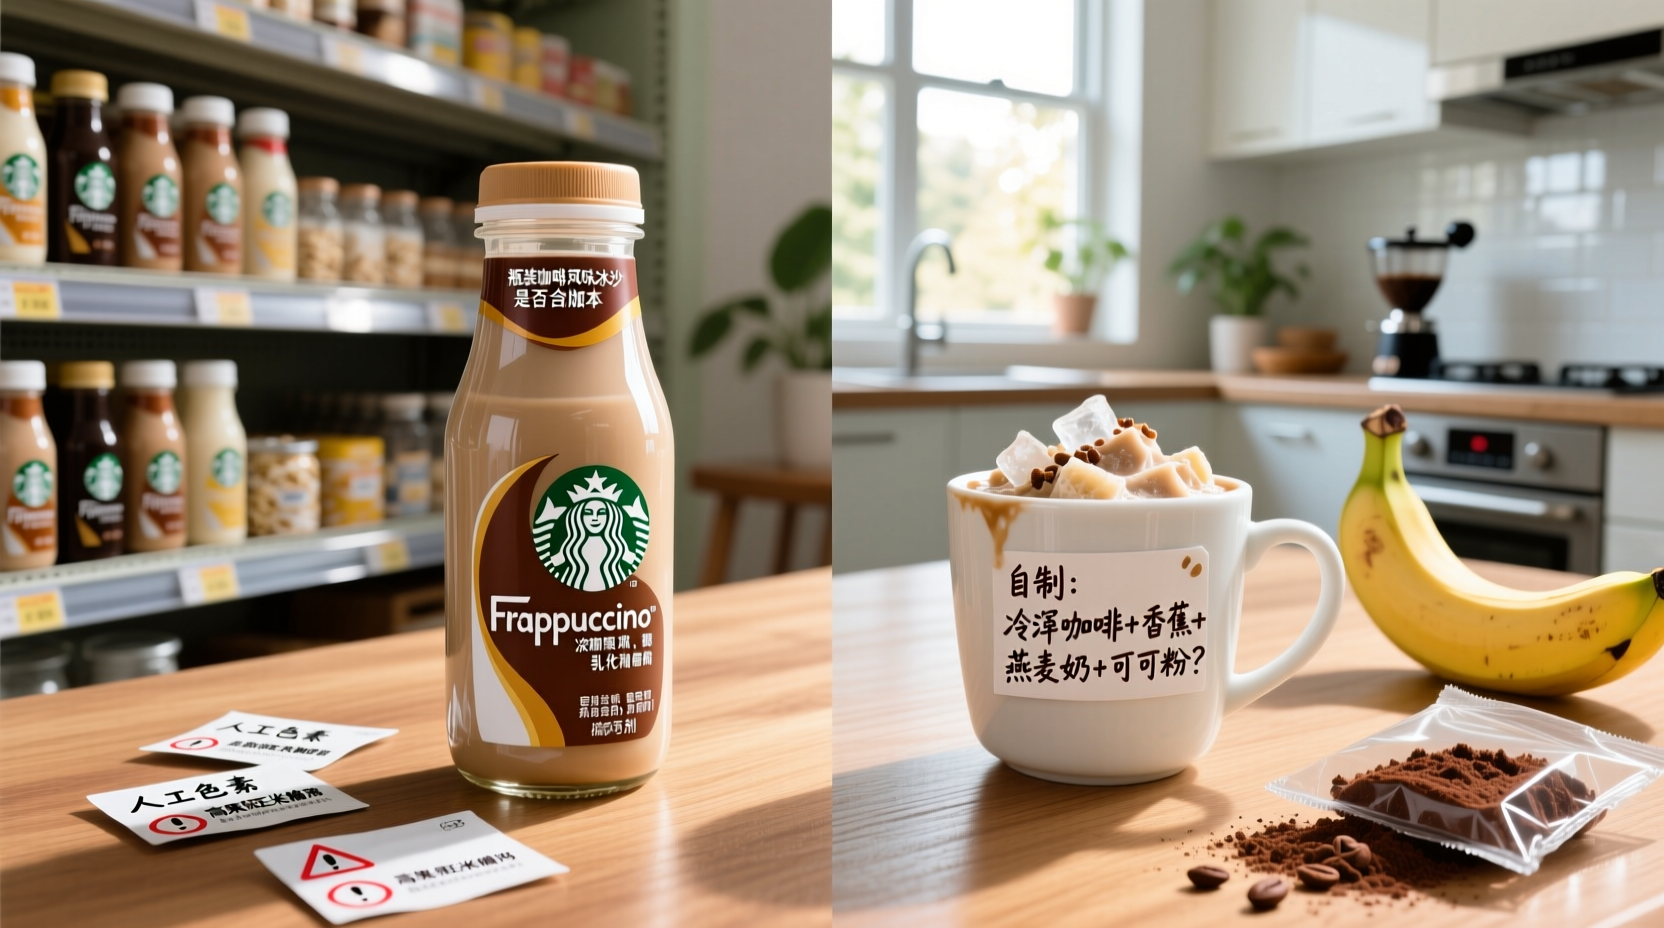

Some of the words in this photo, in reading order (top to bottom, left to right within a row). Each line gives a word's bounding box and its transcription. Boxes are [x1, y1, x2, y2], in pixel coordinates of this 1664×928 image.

[490, 595, 652, 646] Frappuccino
[130, 775, 258, 813] 人工色素
